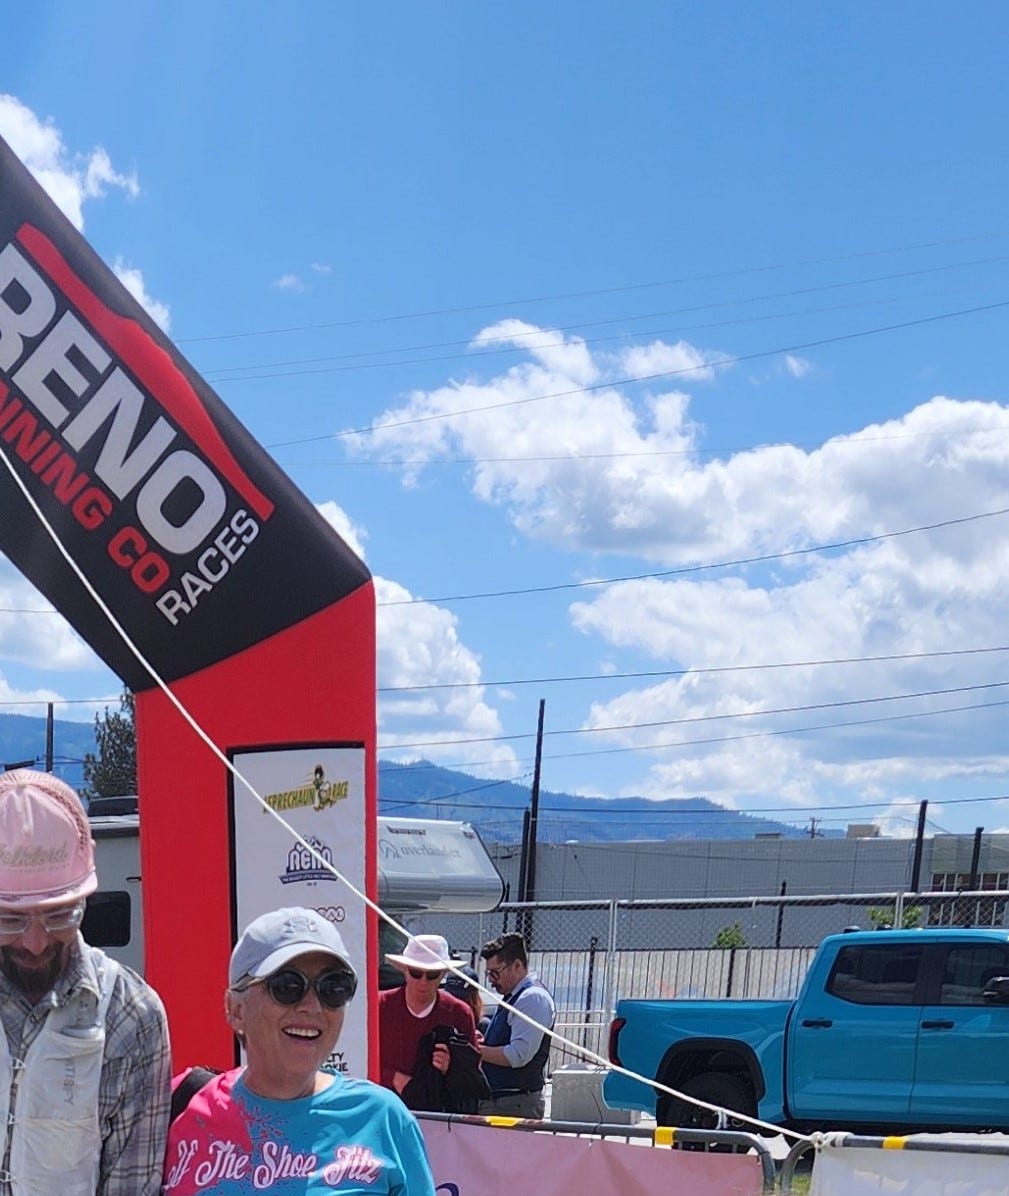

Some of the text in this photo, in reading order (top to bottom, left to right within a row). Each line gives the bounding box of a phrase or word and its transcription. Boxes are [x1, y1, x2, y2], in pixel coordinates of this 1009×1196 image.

[107, 526, 170, 594] CO
[155, 508, 260, 626] RACES
[164, 1139, 384, 1189] If The Shoe Fitz
